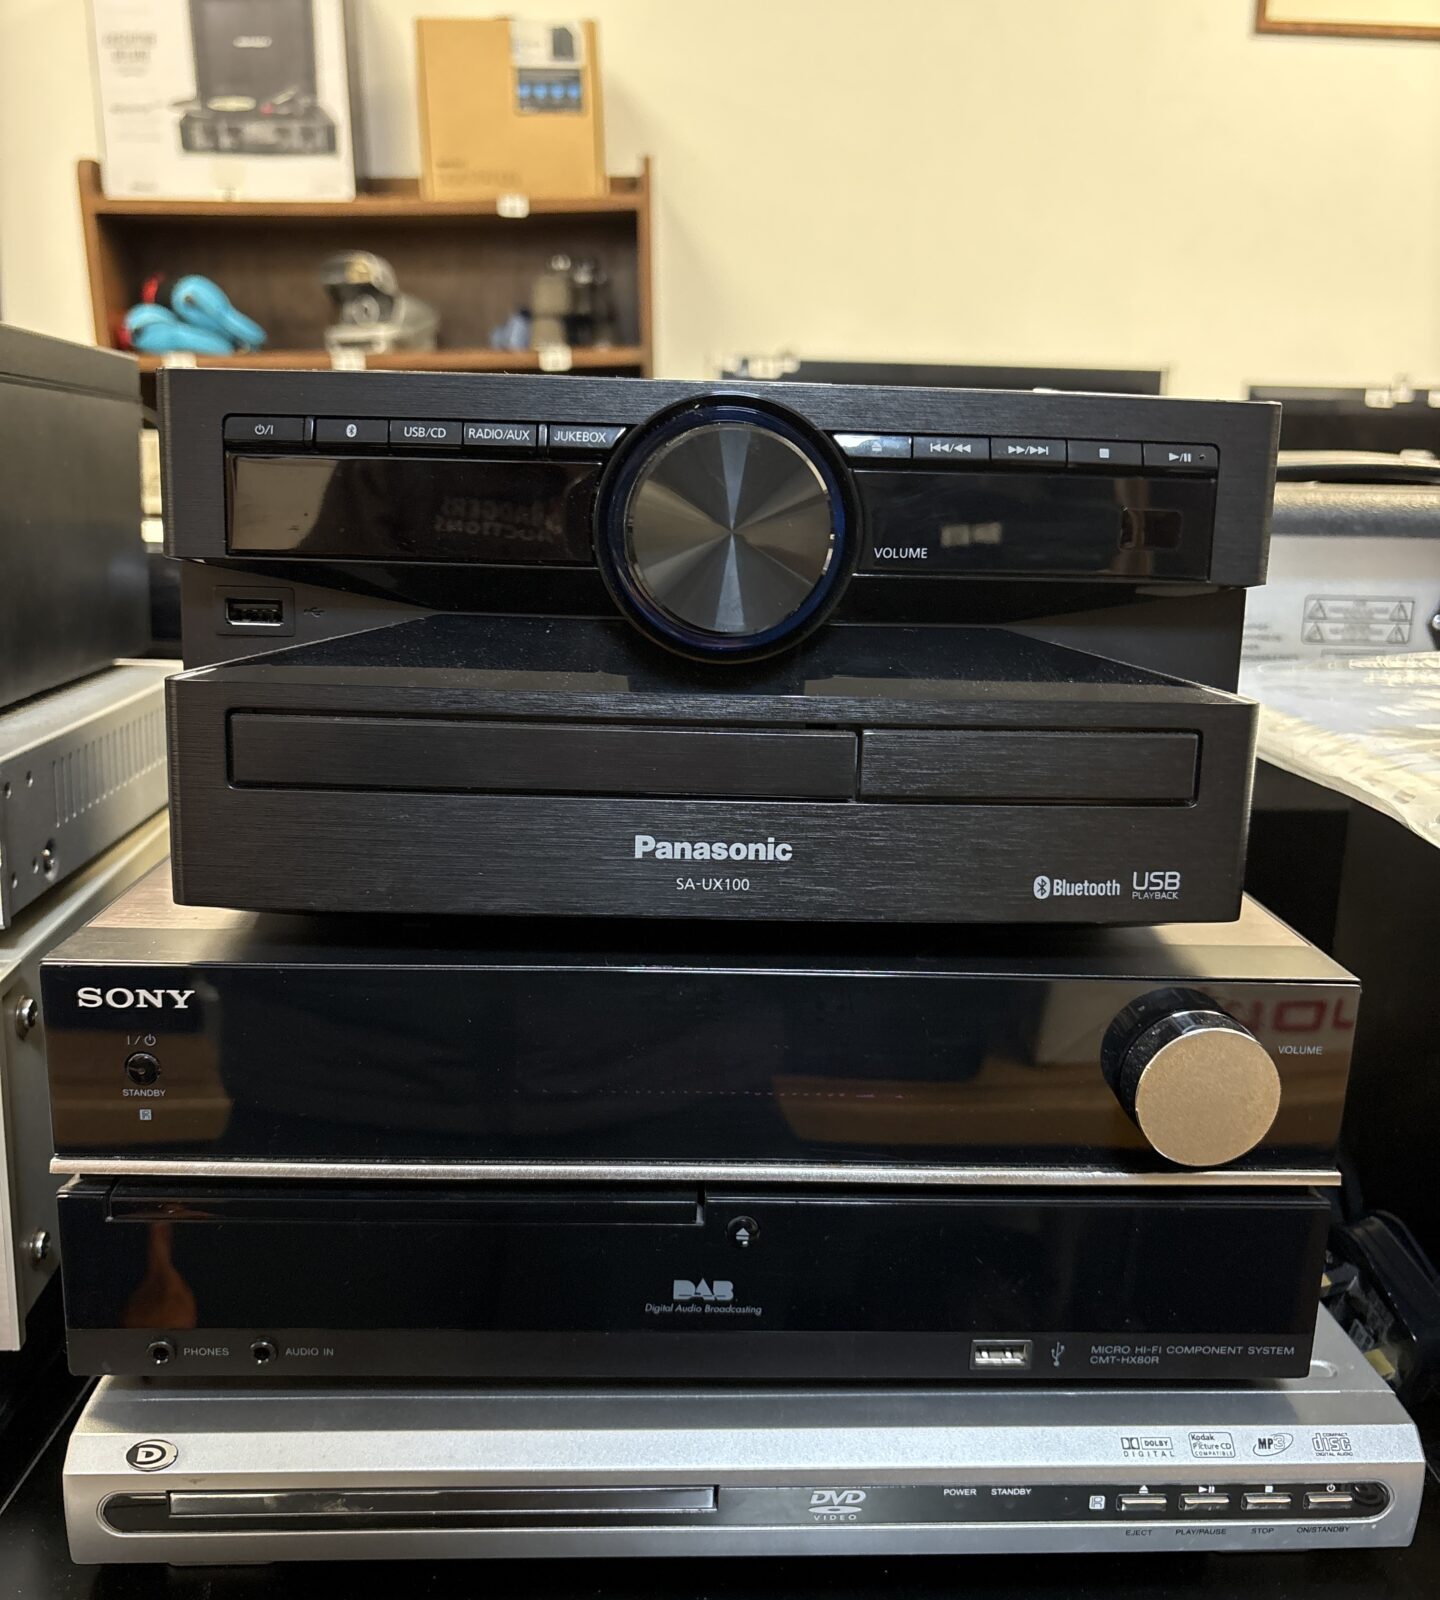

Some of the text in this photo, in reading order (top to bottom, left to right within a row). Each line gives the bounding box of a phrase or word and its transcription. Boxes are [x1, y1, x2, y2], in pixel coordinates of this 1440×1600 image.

[404, 426, 446, 438] USB/CD
[468, 428, 530, 442] RADIO/AUX
[554, 430, 607, 442] JUKEBOX
[874, 548, 928, 559] VOLUME
[634, 835, 793, 862] Panasonic
[676, 878, 750, 891] SA-UX100
[1133, 872, 1181, 890] USB
[1053, 878, 1120, 896] Bluetooth
[1132, 891, 1179, 900] PLAYBACK
[77, 987, 195, 1009] SONY
[1278, 1046, 1322, 1055] VOLUME
[122, 1088, 166, 1097] STANDBY
[673, 1278, 734, 1300] DAB
[645, 1303, 762, 1316] Digital Audio Broadcasting
[184, 1348, 230, 1356] PHONES
[285, 1348, 334, 1356] AUDIO IN
[1091, 1345, 1295, 1356] MICRO HI-FI COMPONENT SYSTEM
[1090, 1356, 1160, 1364] CMT-HX80R
[1192, 1441, 1232, 1450] Picture CD
[1258, 1435, 1286, 1450] MP3
[1312, 1432, 1352, 1452] disc
[1123, 1450, 1175, 1458] DIGITAL
[810, 1490, 866, 1504] DVD
[943, 1488, 976, 1496] POWER
[991, 1488, 1032, 1496] STANDBY
[1125, 1529, 1152, 1537] EJECT
[1176, 1528, 1227, 1536] PLAY/PAUSE
[1251, 1527, 1275, 1535] STOP
[1296, 1526, 1350, 1534] ON/STANDBY
